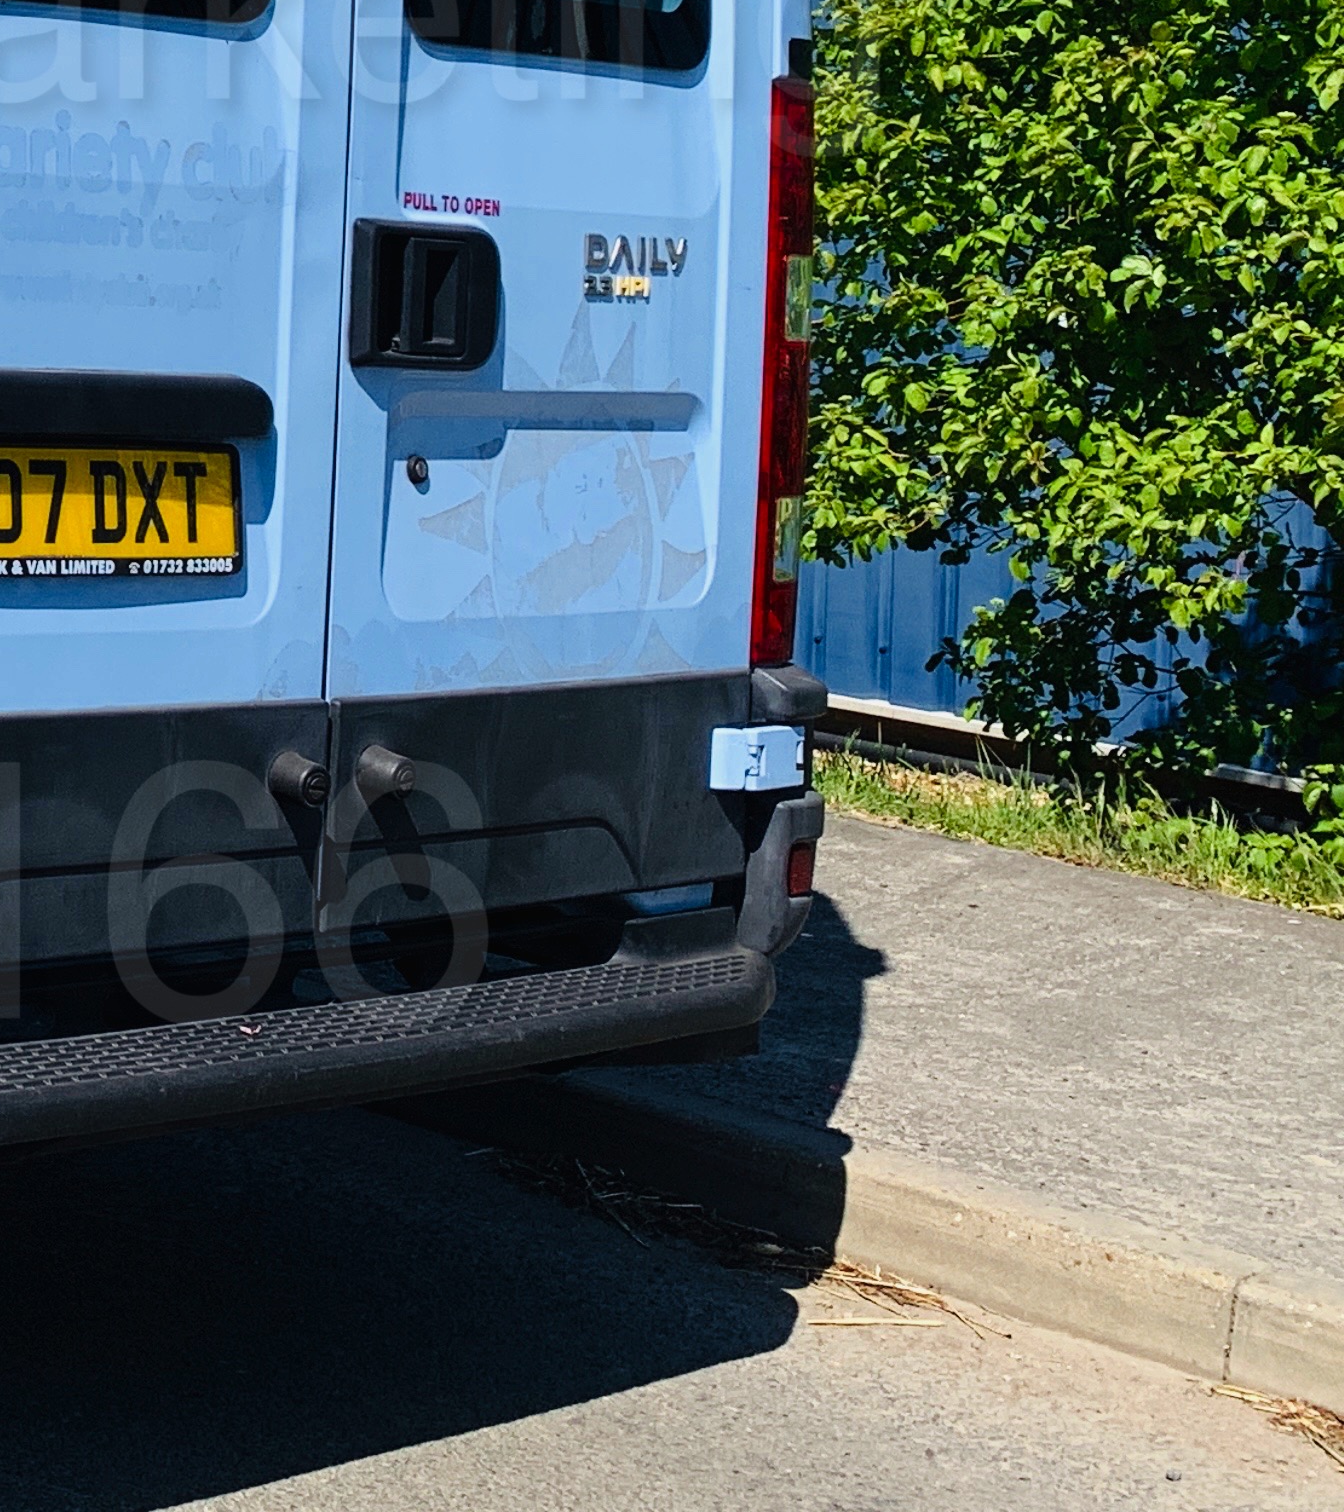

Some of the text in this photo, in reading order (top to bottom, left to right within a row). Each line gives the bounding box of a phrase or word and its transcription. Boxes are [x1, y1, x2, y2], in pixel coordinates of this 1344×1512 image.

[403, 191, 500, 216] PULL TO OPEN
[583, 233, 688, 276] DAILY
[89, 460, 208, 544] DXT
[11, 559, 24, 575] &
[27, 559, 57, 575] VAN
[60, 558, 116, 575] LIMITED
[143, 558, 184, 574] 01732
[186, 557, 234, 574] 833005
